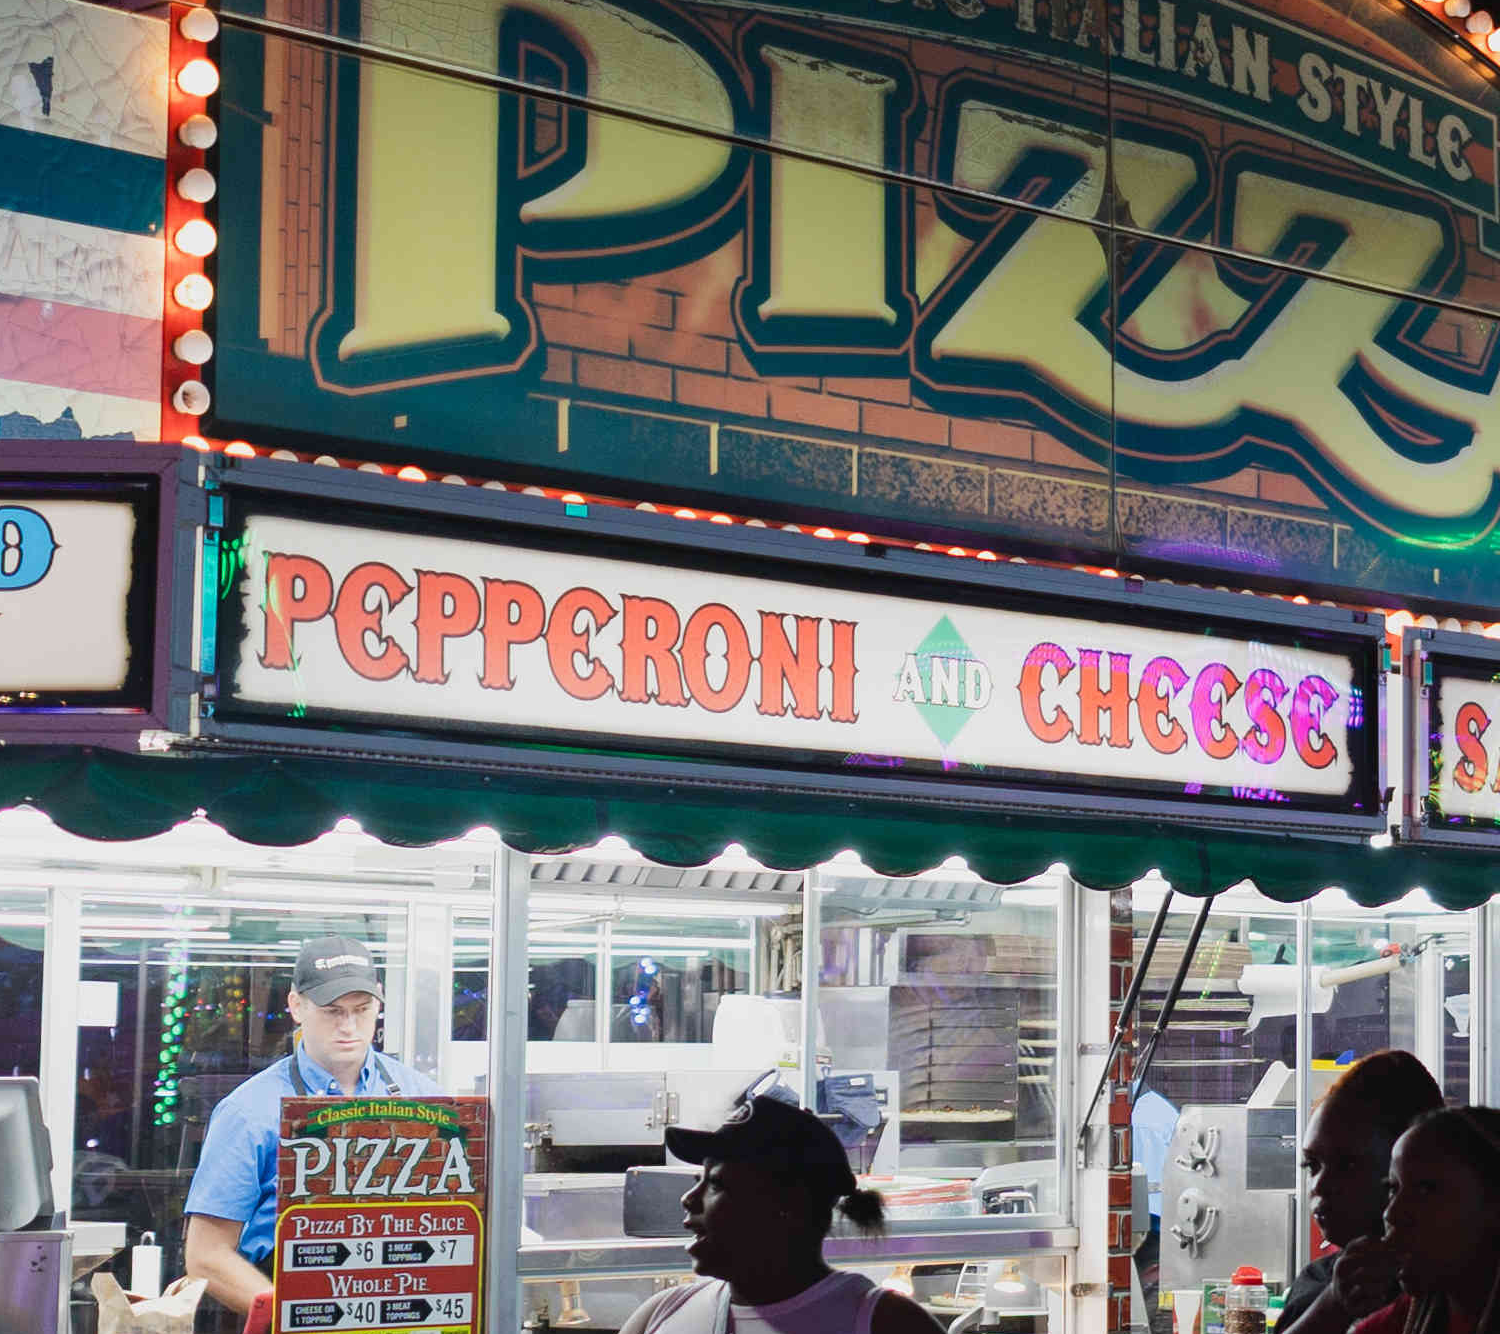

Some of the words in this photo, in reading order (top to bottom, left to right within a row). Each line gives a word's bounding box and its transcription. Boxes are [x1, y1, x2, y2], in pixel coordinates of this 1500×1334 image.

[1297, 53, 1473, 181] STYLE
[257, 550, 860, 724] PEPPERONI
[893, 651, 995, 710] AND
[1015, 641, 1340, 769] CHEESE
[317, 1105, 366, 1124] Classic
[368, 1101, 414, 1117] Italian
[416, 1106, 450, 1124] Style
[279, 1136, 476, 1198] PIZZA
[418, 1213, 468, 1235] SLICE
[297, 1245, 327, 1255] CHEESE
[327, 1244, 338, 1254] OR
[355, 1241, 374, 1262] $6
[387, 1253, 423, 1262] TOPPINGS
[394, 1242, 413, 1252] MEAT
[439, 1239, 458, 1260] $7
[303, 1255, 336, 1265] TOPPING
[326, 1272, 396, 1297] WHOLE
[394, 1272, 431, 1294] PIE
[295, 1306, 325, 1315] CHEESE
[325, 1305, 336, 1314] OR
[346, 1301, 376, 1323] $40
[385, 1311, 421, 1321] TOPPINGS
[392, 1301, 411, 1311] MEAT
[436, 1298, 464, 1319] $45
[301, 1315, 333, 1325] TOPPING
